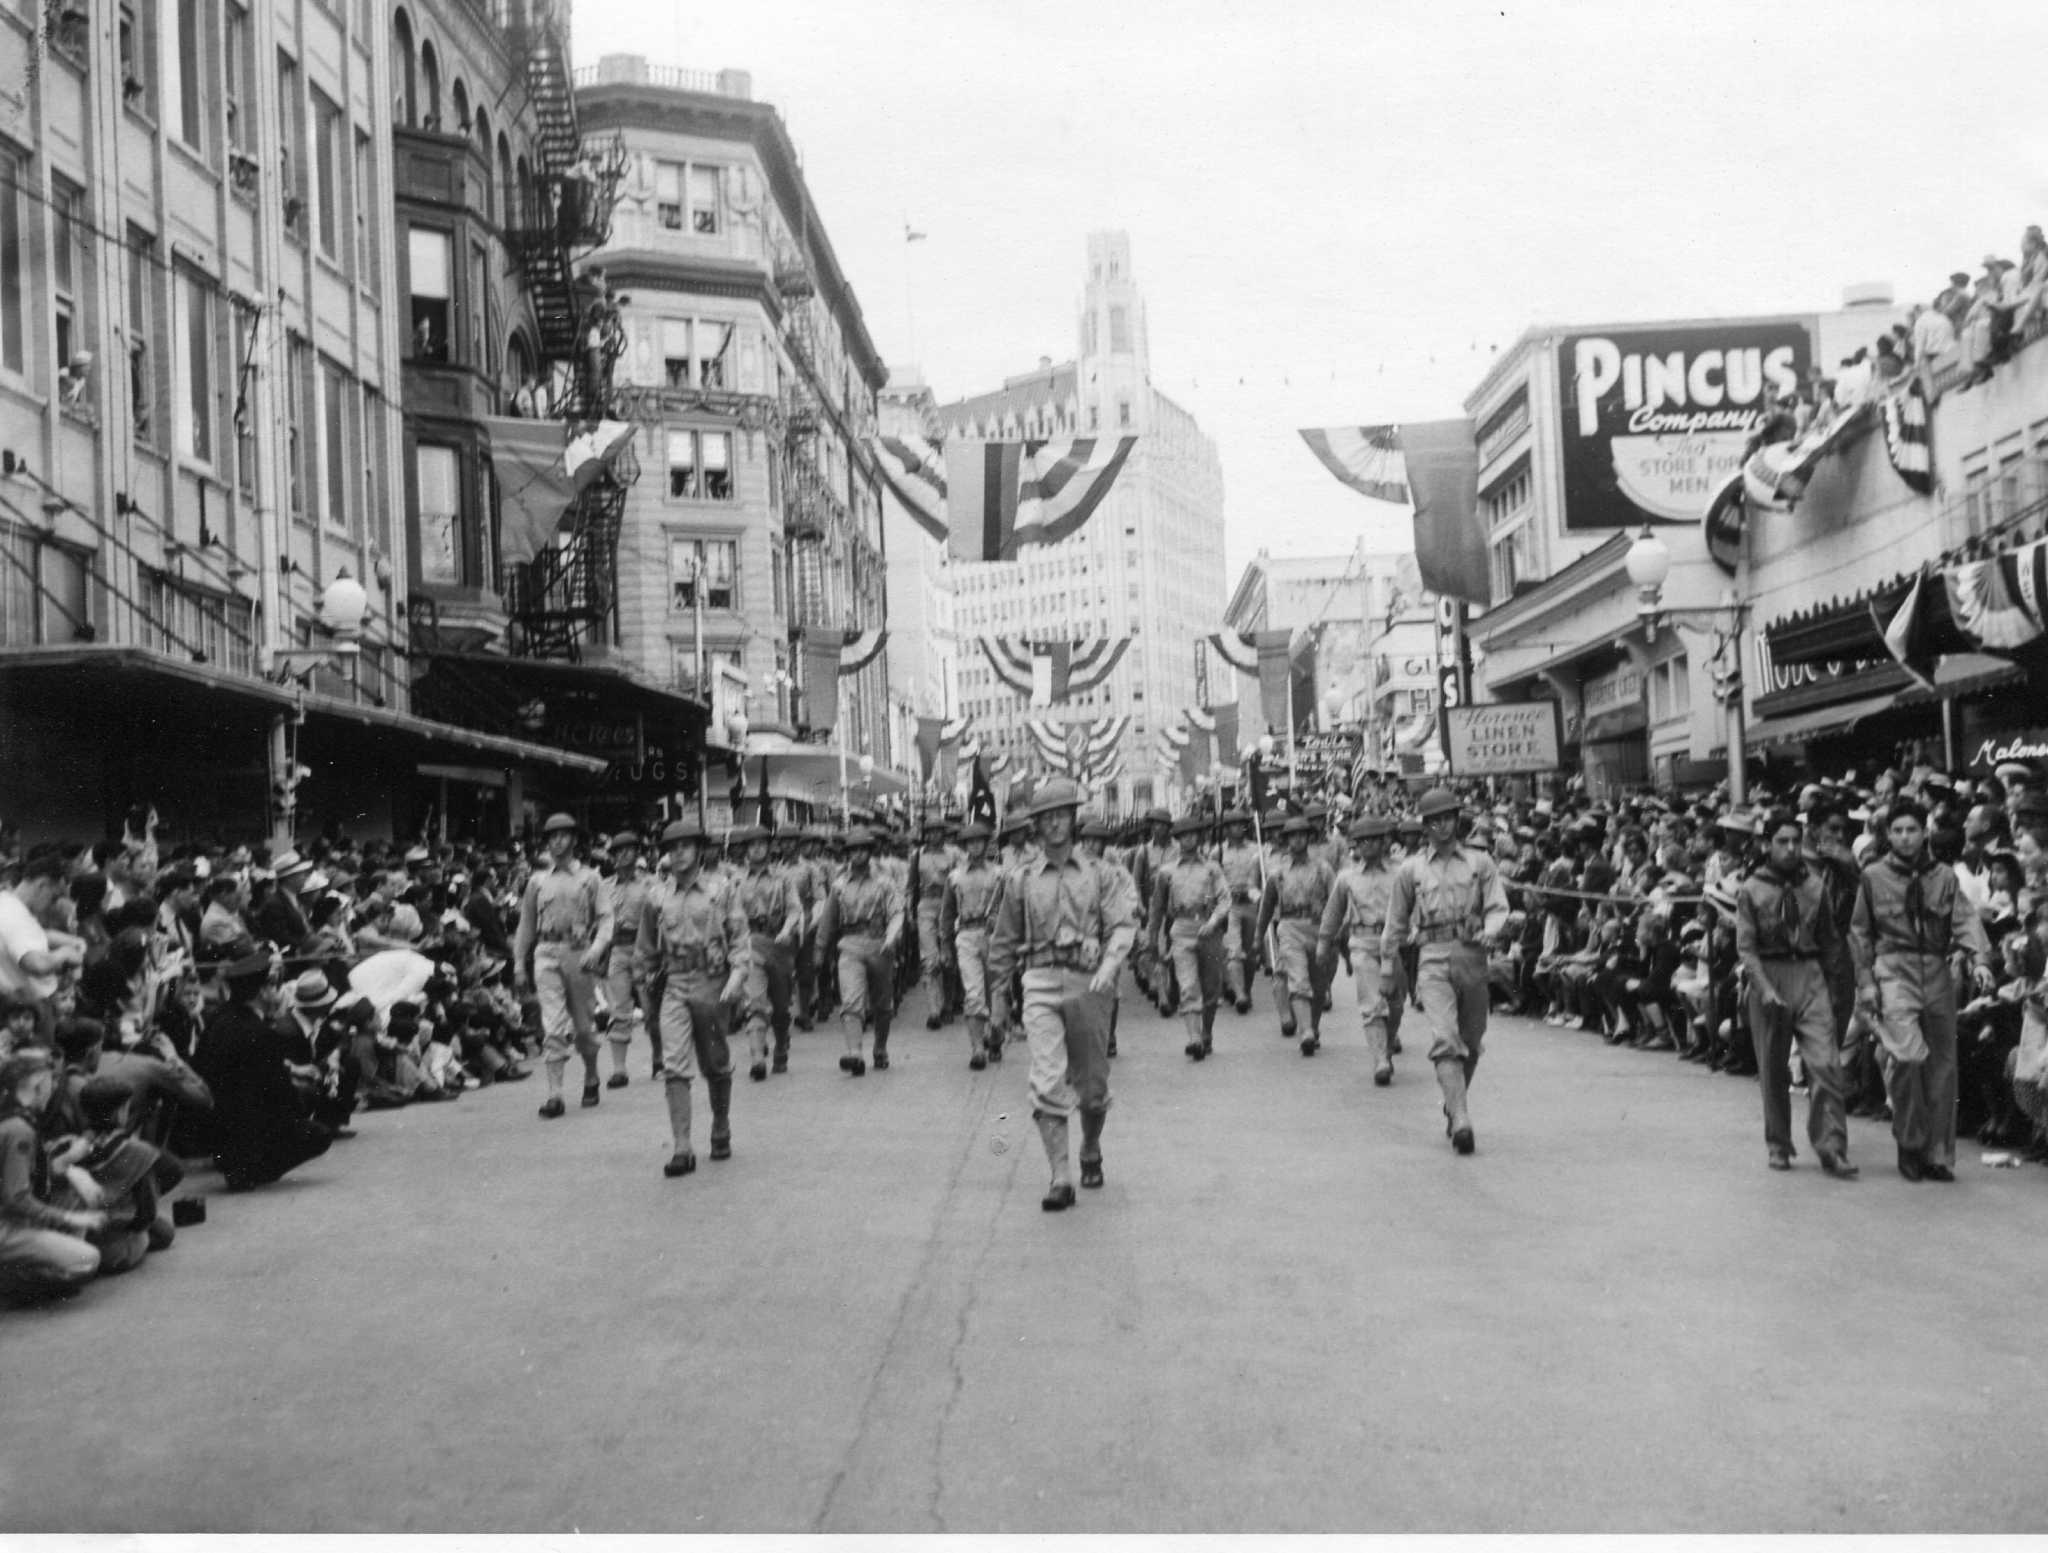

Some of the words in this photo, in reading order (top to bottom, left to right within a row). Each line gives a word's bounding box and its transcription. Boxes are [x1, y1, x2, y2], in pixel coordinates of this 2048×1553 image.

[1575, 338, 1797, 436] PINCUS
[1629, 407, 1759, 434] Company
[1639, 456, 1695, 476] STORE
[1669, 477, 1709, 495] MEN
[1473, 725, 1534, 741] LINEN
[1467, 743, 1540, 759] STORE
[1971, 738, 2048, 766] Malone
